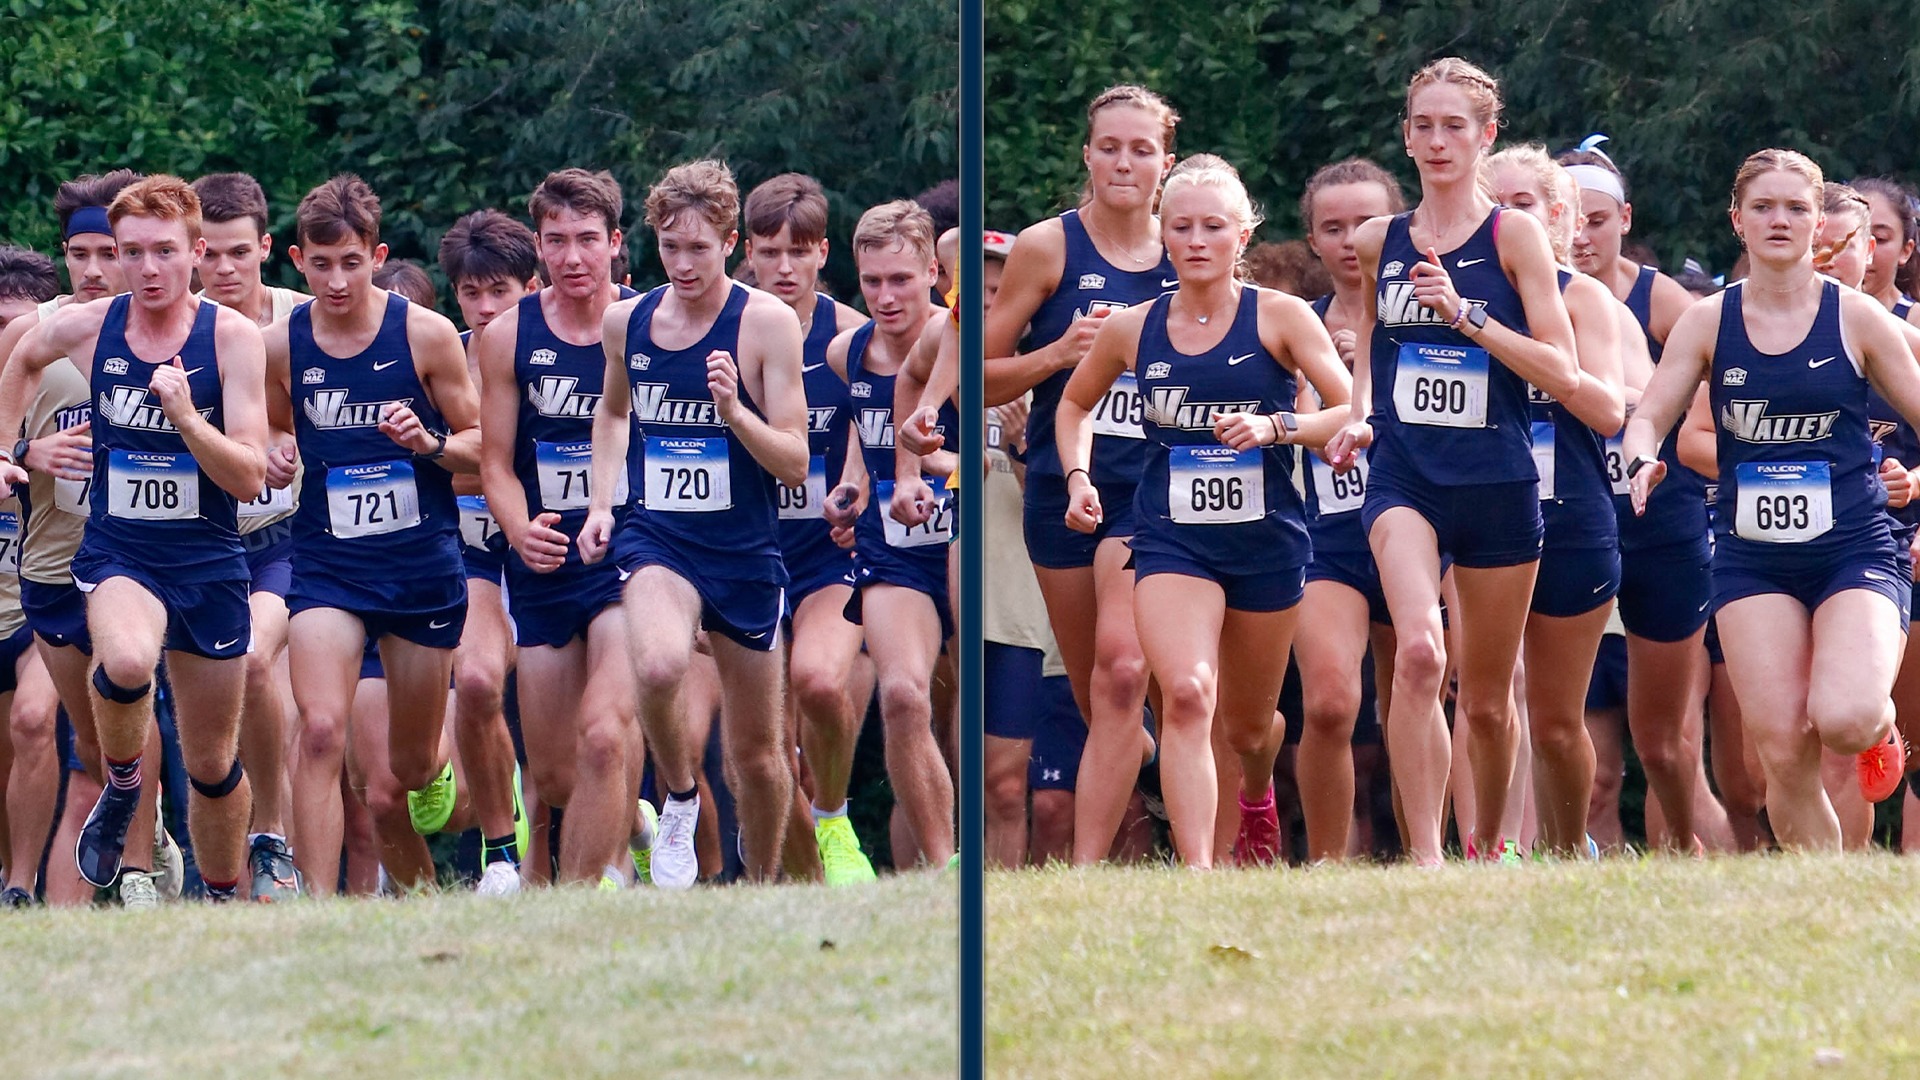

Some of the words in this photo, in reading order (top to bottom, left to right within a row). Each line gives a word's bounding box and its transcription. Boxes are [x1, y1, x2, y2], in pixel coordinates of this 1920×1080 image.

[1385, 282, 1487, 326] VALL
[1418, 347, 1467, 358] FALCON
[111, 386, 213, 432] VALL
[314, 389, 412, 429] VALLE
[1414, 376, 1466, 414] 690
[1731, 400, 1838, 442] VALLEY
[127, 453, 176, 462] FALCON
[556, 443, 592, 453] FALCO
[660, 440, 706, 448] FALCON
[1190, 448, 1240, 456] FALCON
[344, 464, 392, 475] FALCON
[557, 469, 591, 500] 71
[660, 468, 710, 500] 720
[1331, 466, 1364, 500] 69
[1757, 465, 1807, 473] FALCON
[127, 479, 179, 509] 708
[347, 490, 399, 526] 721
[778, 484, 807, 509] 09
[1191, 477, 1243, 512] 696
[1757, 495, 1809, 530] 693
